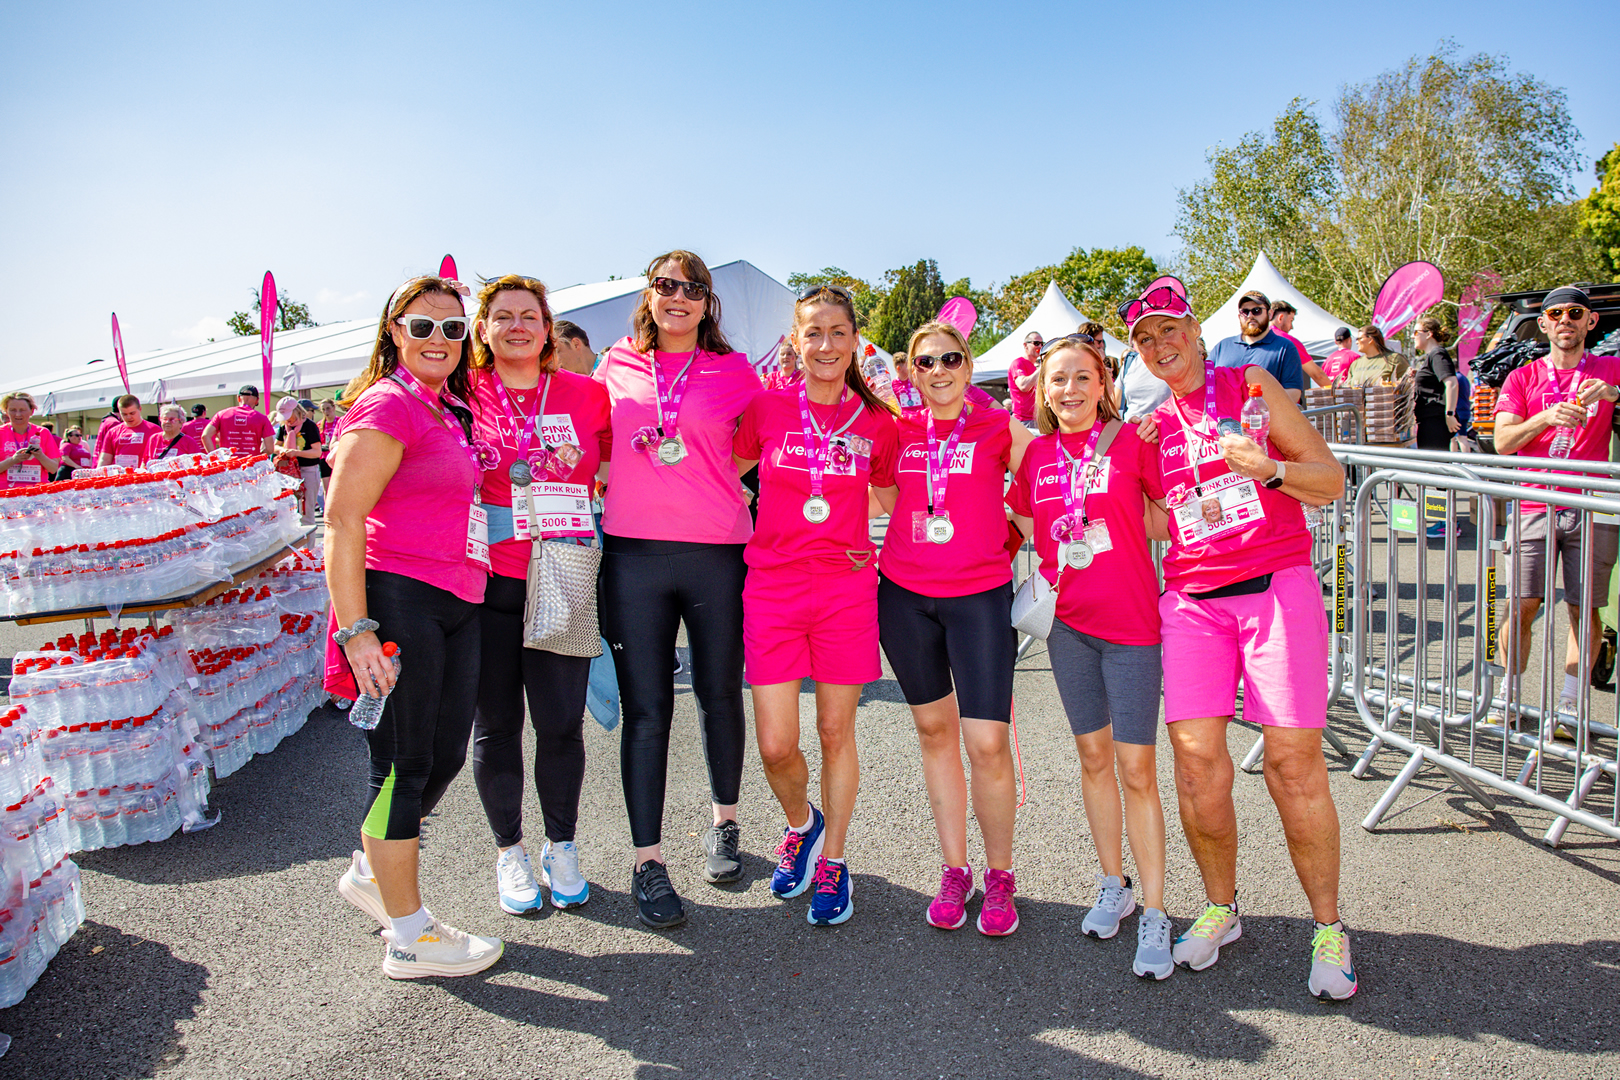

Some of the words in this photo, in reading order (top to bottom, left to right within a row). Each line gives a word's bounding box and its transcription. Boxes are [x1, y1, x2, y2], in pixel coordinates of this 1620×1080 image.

[541, 425, 572, 434] PINK
[543, 433, 572, 444] RUN
[1162, 442, 1188, 458] very
[1039, 475, 1059, 486] ver
[1201, 481, 1222, 492] PINK
[1223, 474, 1244, 485] RUN
[565, 486, 582, 494] RUN
[473, 509, 485, 519] VERY
[541, 517, 567, 528] 5006
[388, 947, 417, 962] HOKA
